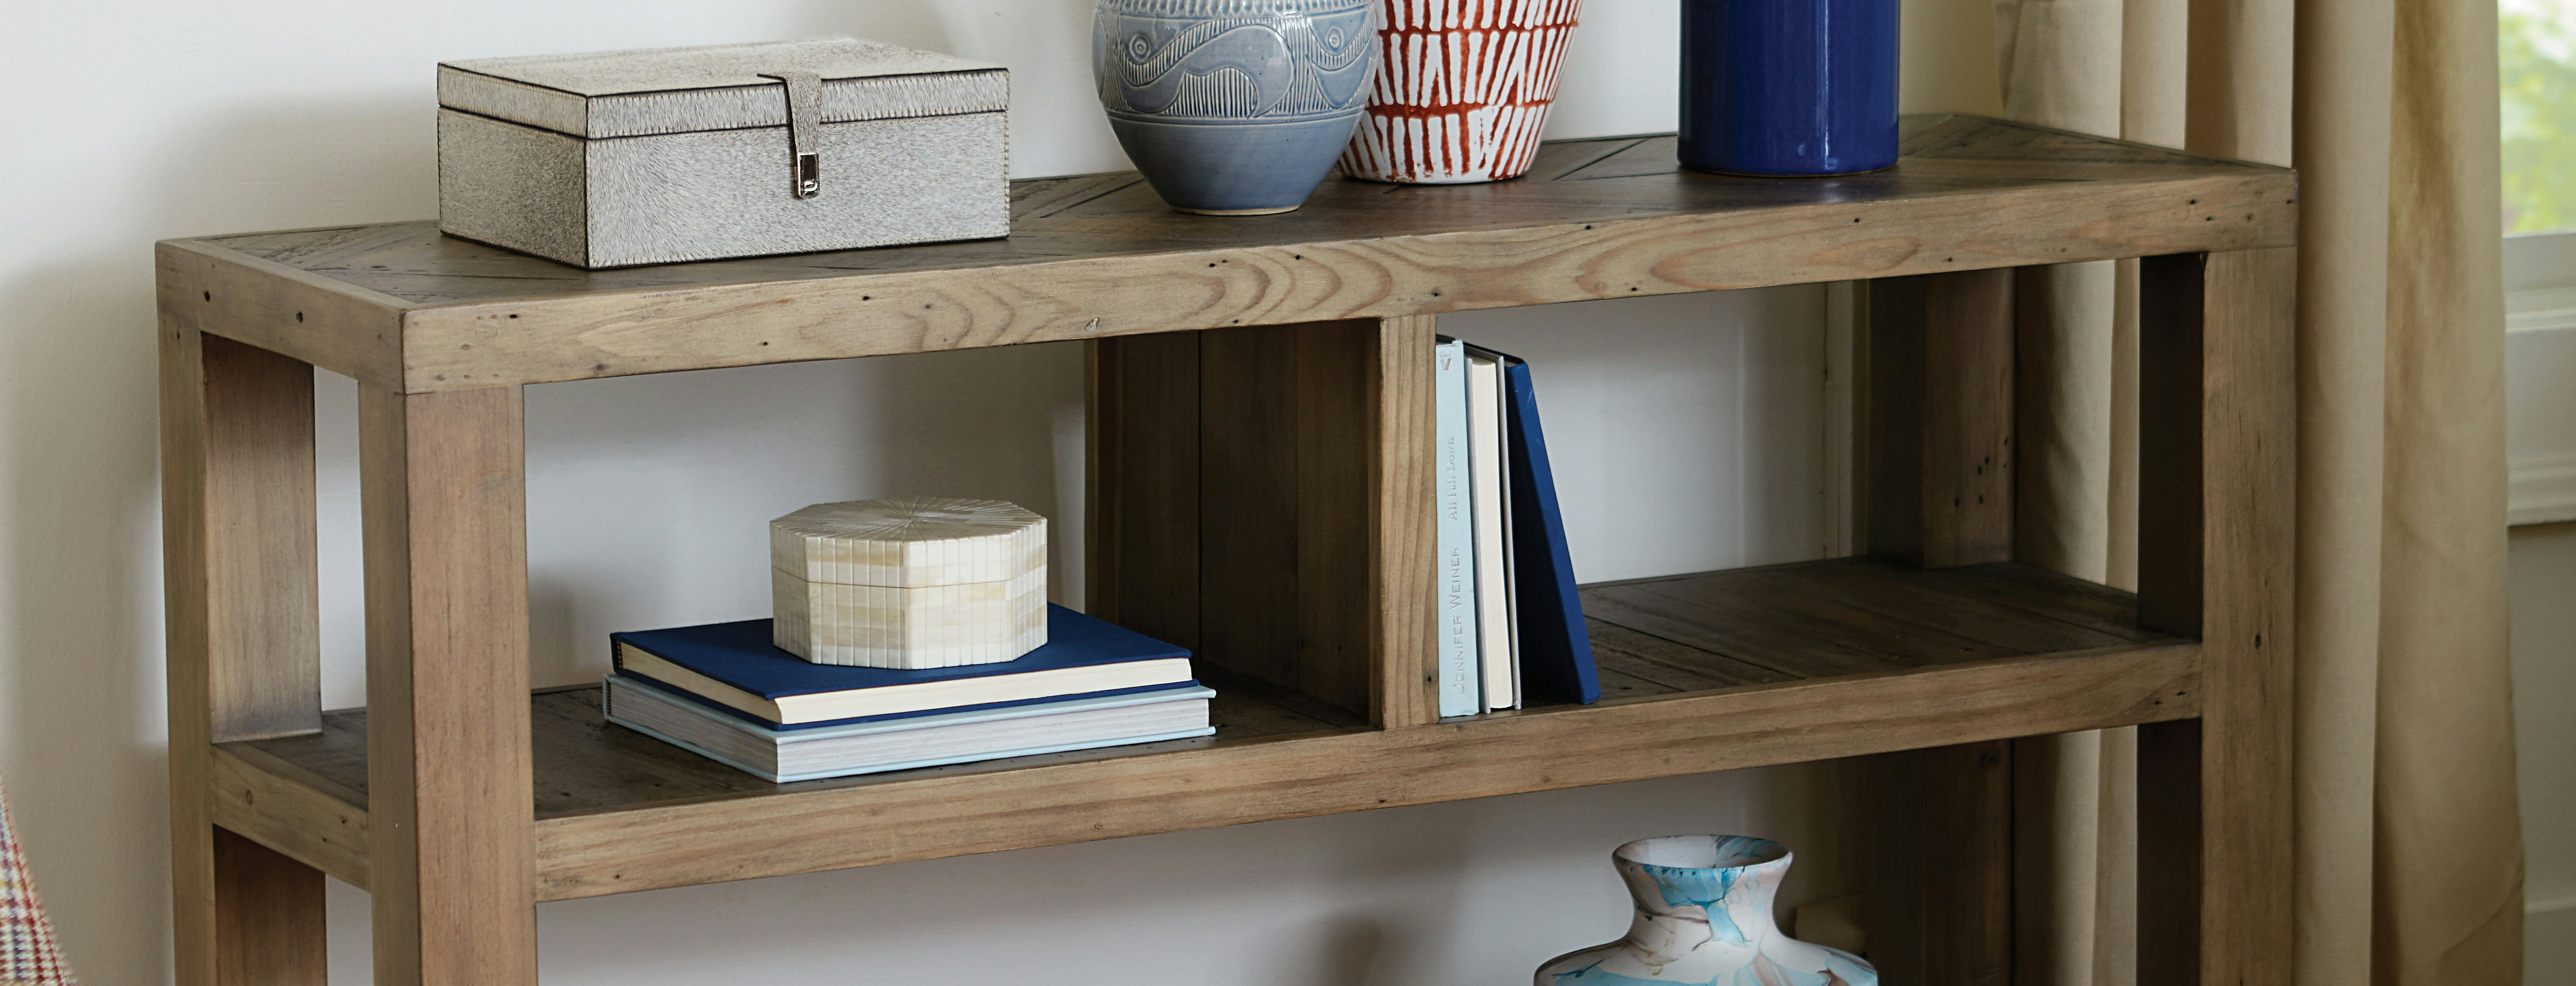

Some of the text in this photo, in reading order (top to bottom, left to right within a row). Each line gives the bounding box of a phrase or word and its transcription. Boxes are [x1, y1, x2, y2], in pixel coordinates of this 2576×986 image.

[1446, 438, 1458, 520] All Fall Down
[1450, 547, 1465, 695] JENNIFER WEINER
